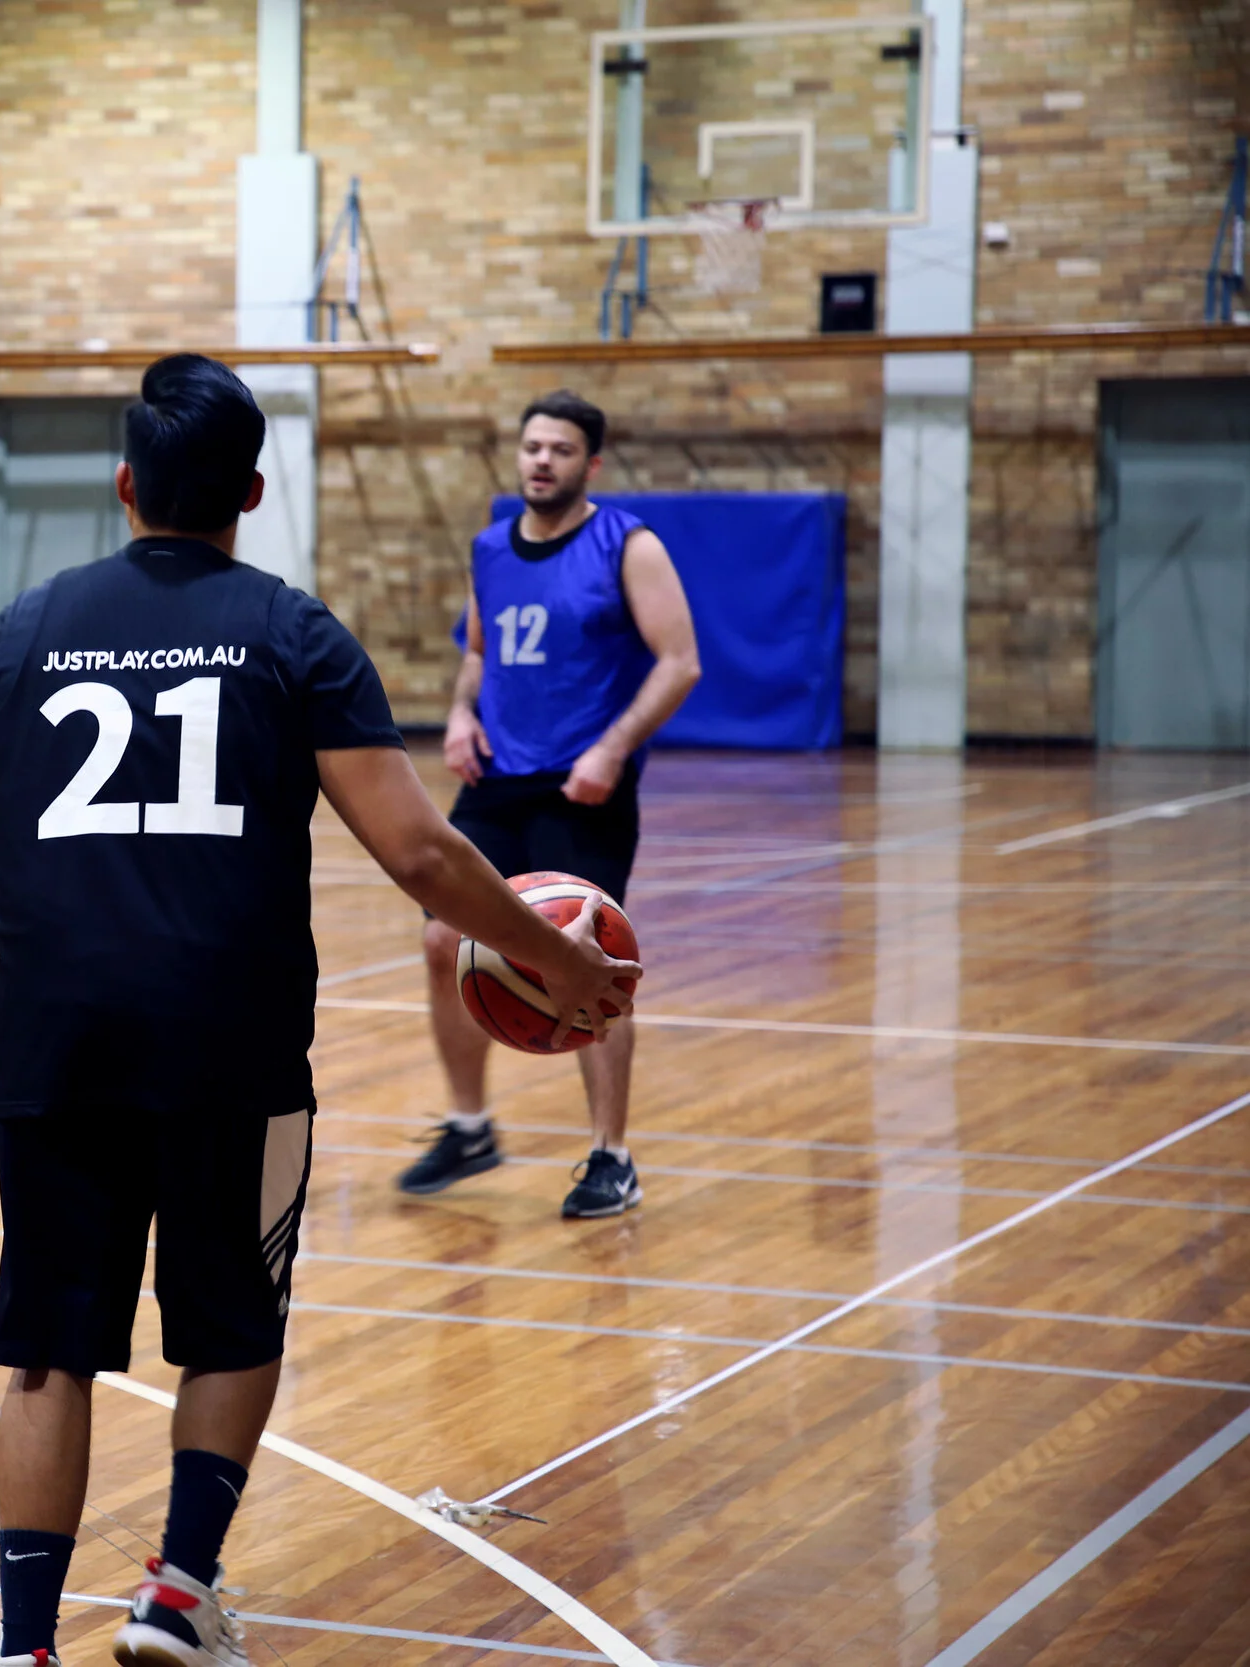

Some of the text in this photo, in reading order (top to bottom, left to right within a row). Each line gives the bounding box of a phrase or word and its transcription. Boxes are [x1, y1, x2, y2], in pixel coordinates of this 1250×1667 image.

[43, 645, 246, 672] JUSTPLAY.COM.AU
[495, 603, 548, 666] 12
[37, 676, 245, 840] 21
